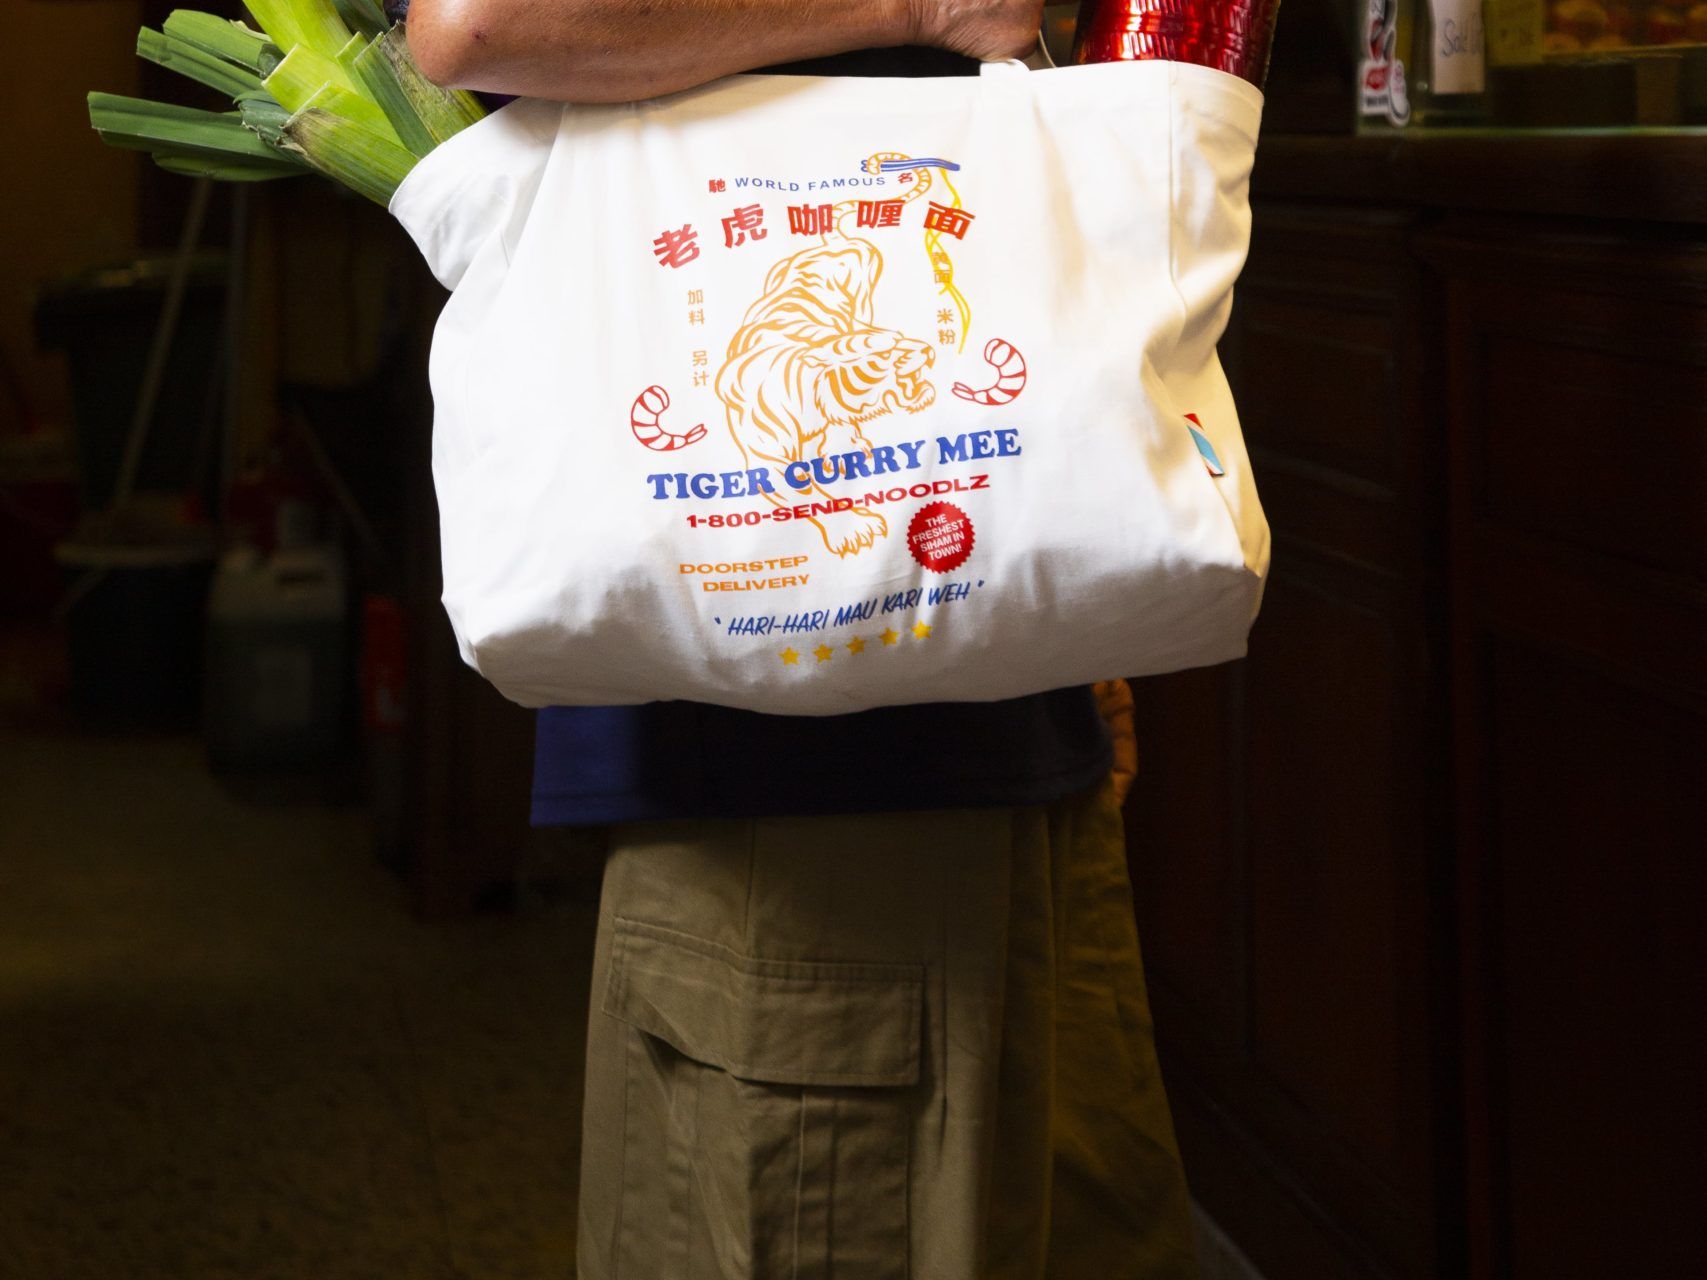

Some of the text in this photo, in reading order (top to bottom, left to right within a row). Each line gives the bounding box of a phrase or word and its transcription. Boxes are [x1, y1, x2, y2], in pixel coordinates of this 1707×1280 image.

[735, 176, 886, 192] WORLD FAMOUS
[897, 172, 914, 184] 名
[653, 199, 976, 269] 老虎咖喱面
[687, 289, 705, 326] 加料
[937, 308, 956, 345] 米粉
[646, 428, 1022, 500] TIGER CURRY MEE
[686, 474, 991, 528] 1-800-SEND-NOODLZ
[912, 519, 965, 545] FRESHEST
[925, 513, 948, 528] THE
[920, 531, 965, 552] SIHAM IN
[928, 543, 963, 561] TOWN!
[679, 555, 809, 575] DOORSTEP
[702, 574, 810, 592] DELIVERY
[833, 598, 877, 627] MAU
[881, 587, 923, 614] KARI
